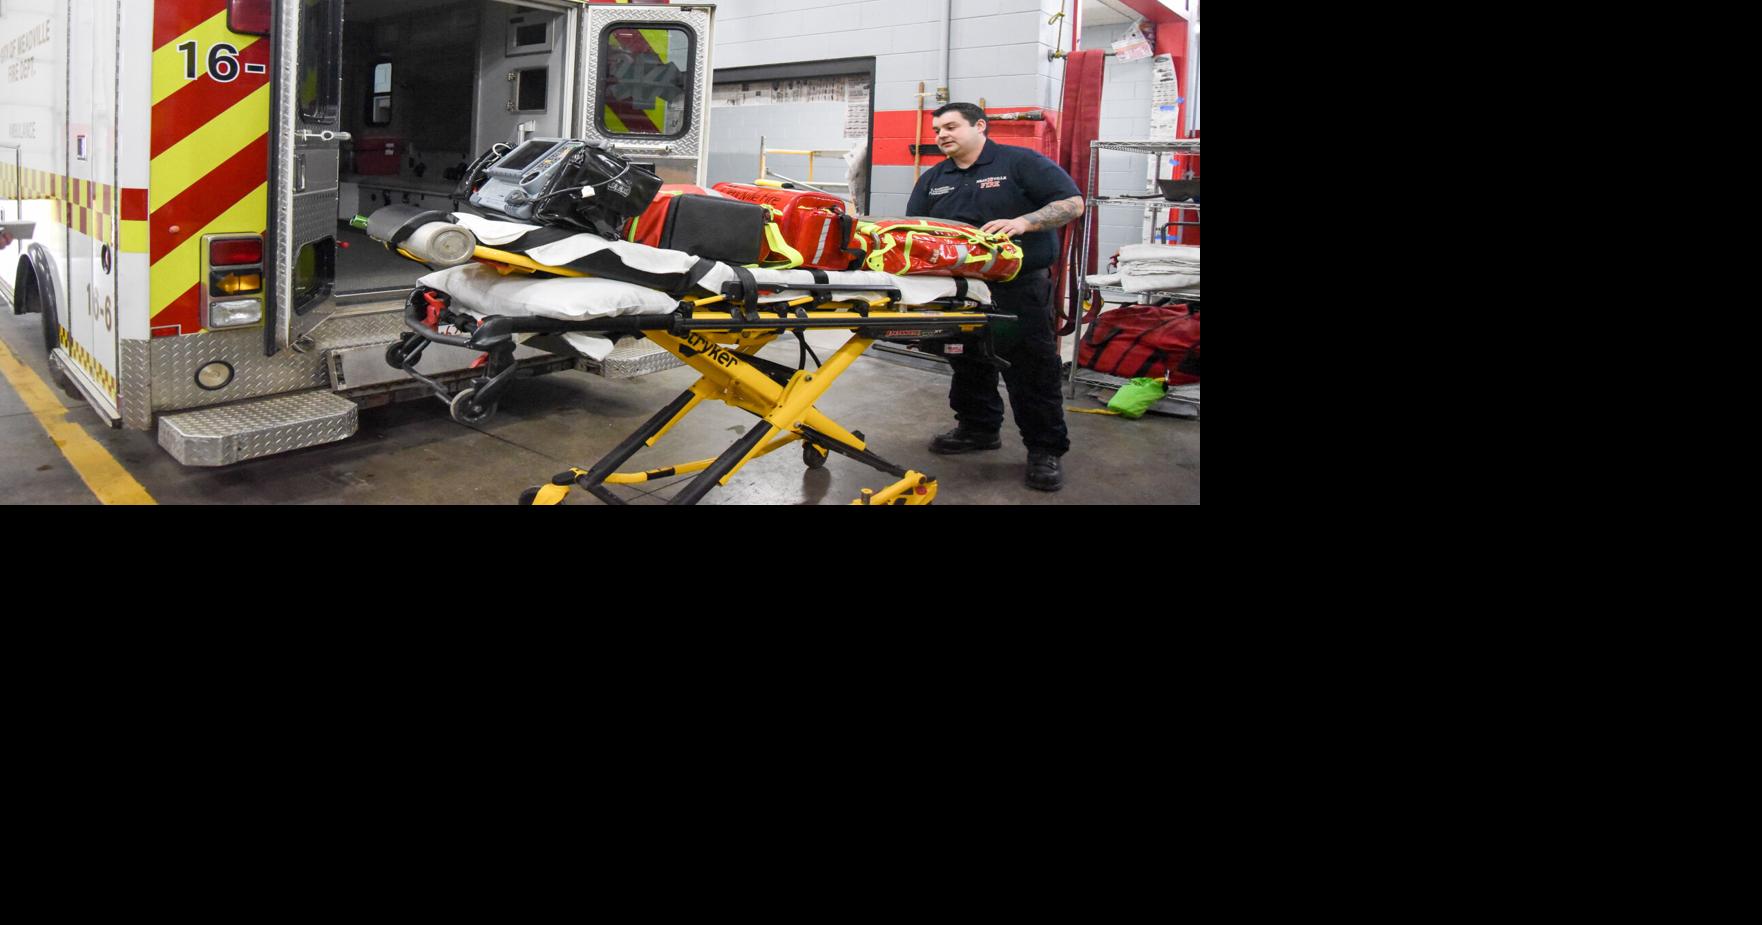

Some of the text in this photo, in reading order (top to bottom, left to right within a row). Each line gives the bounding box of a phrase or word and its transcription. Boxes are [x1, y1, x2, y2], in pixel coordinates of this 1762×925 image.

[17, 19, 50, 55] MEADVILLE
[176, 40, 266, 82] 16-
[86, 283, 112, 331] 16-6
[684, 332, 738, 368] tryker
